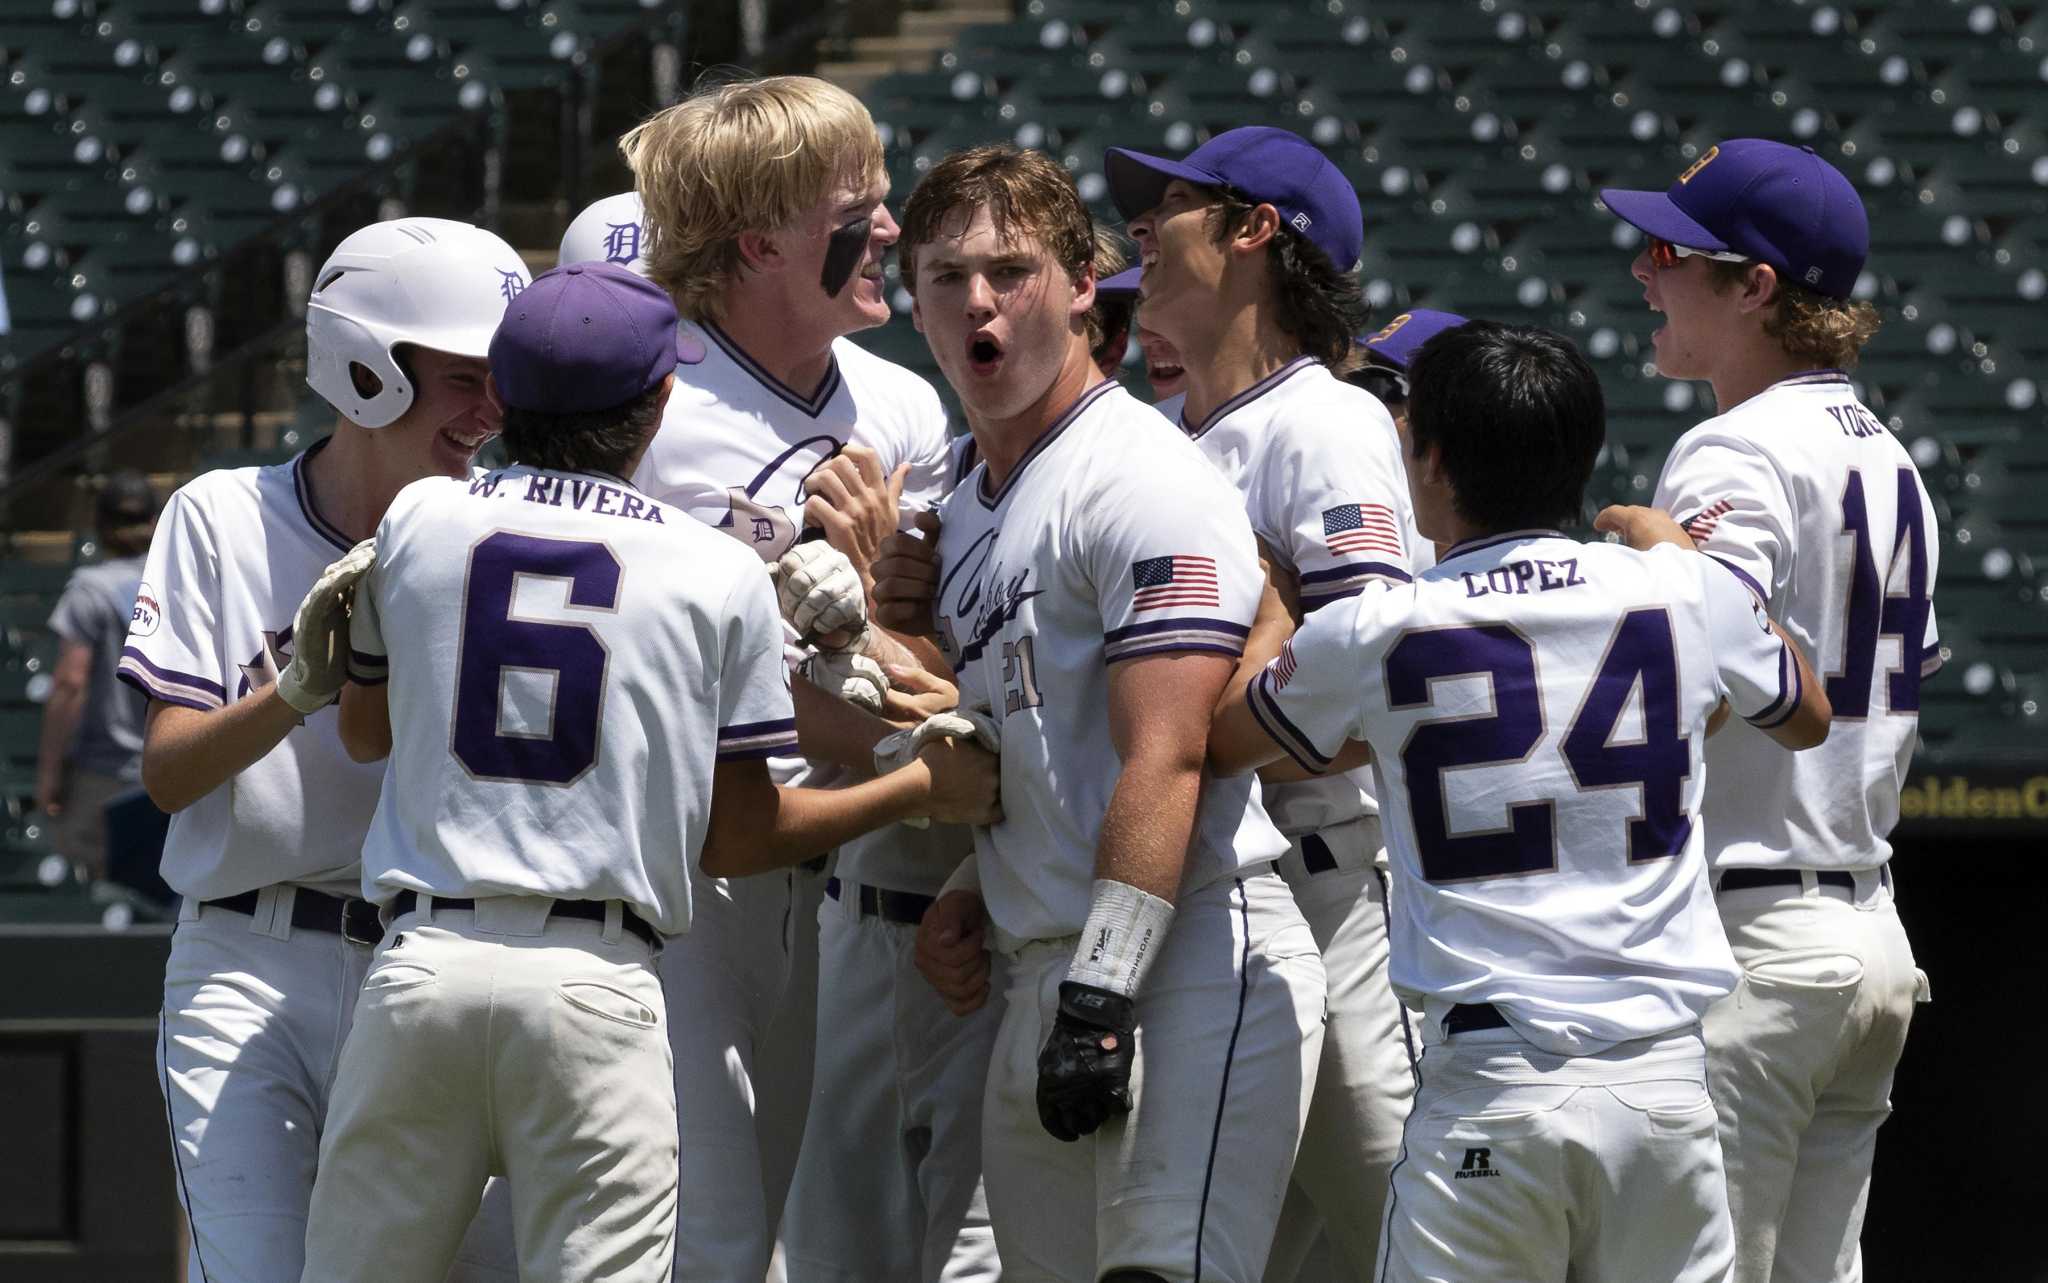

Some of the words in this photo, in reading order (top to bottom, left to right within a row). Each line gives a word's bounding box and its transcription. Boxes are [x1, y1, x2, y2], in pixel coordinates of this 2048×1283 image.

[602, 222, 640, 265] D
[523, 474, 664, 524] RIVERA
[750, 518, 775, 543] D
[1461, 558, 1586, 598] LOPEZ
[1823, 464, 1932, 723] 14
[448, 528, 627, 788] 6
[1382, 604, 1692, 883] 24
[1901, 777, 2047, 818] oldenC
[1455, 1169, 1501, 1179] RUSSELL
[1462, 1148, 1491, 1169] R
